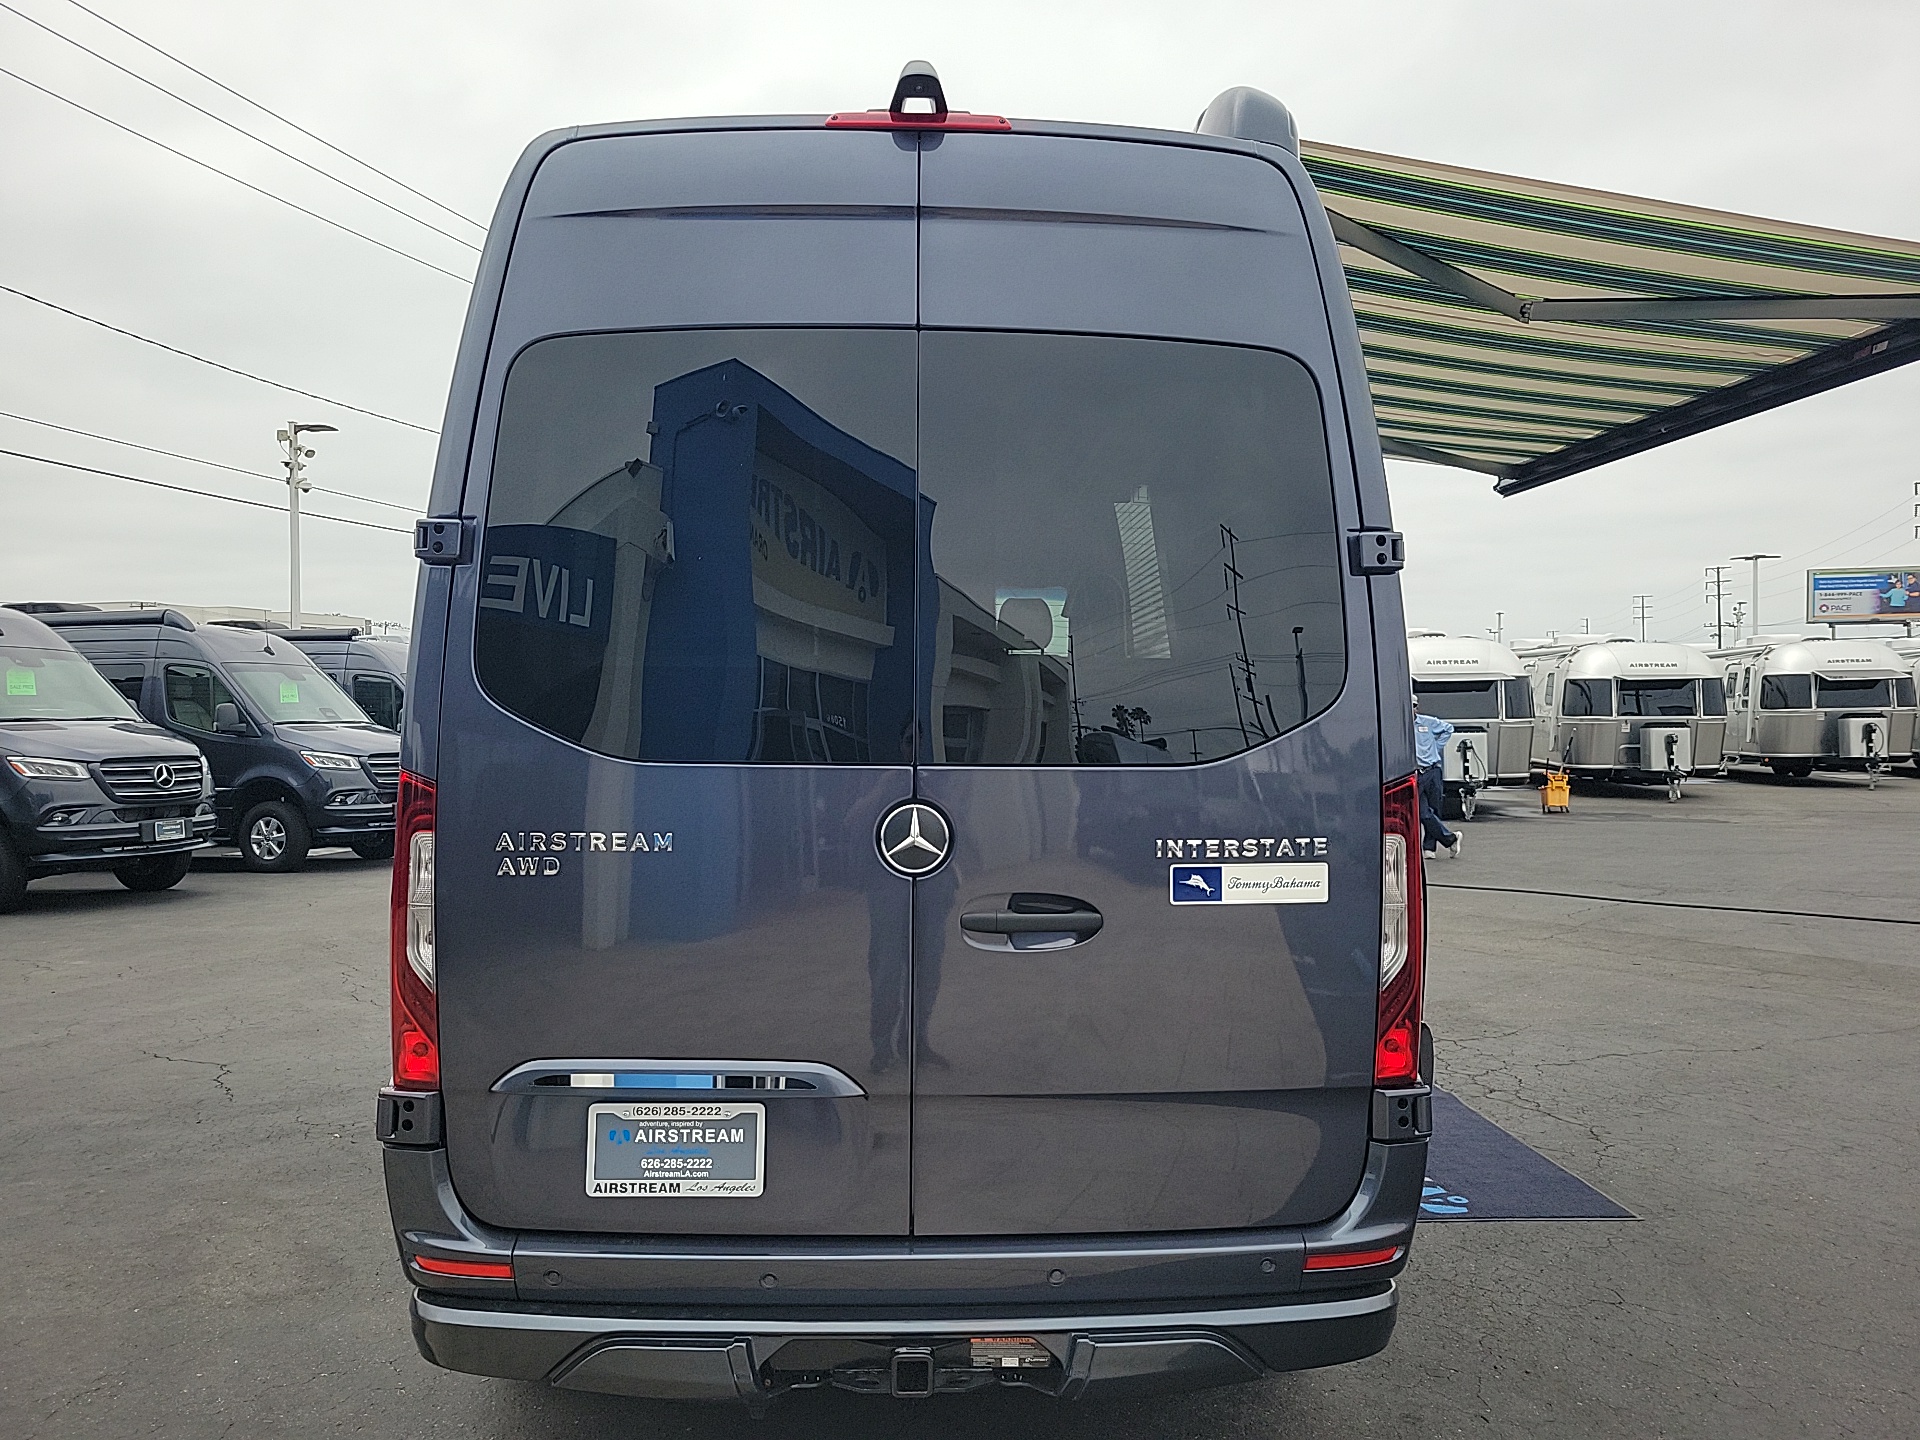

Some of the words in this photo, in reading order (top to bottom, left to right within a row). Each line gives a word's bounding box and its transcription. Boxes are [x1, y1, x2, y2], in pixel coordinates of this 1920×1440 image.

[1830, 604, 1852, 612] PACE
[495, 832, 674, 852] AIRSTREAM
[1155, 837, 1329, 858] INTERSTATE
[496, 856, 561, 876] AWD
[1227, 876, 1273, 893] Tommy
[1270, 876, 1322, 889] Bahama
[632, 1106, 662, 1117] (626)
[663, 1106, 722, 1116] 285-2222
[671, 1120, 695, 1128] inspired
[695, 1120, 703, 1128] by
[634, 1129, 744, 1143] AIRSTREAM
[640, 1158, 713, 1169] 626-285-2222
[643, 1170, 709, 1178] AirstreamLA.com
[592, 1182, 681, 1194] AIRSTREAM
[685, 1182, 708, 1192] Los
[710, 1182, 756, 1195] Angeles
